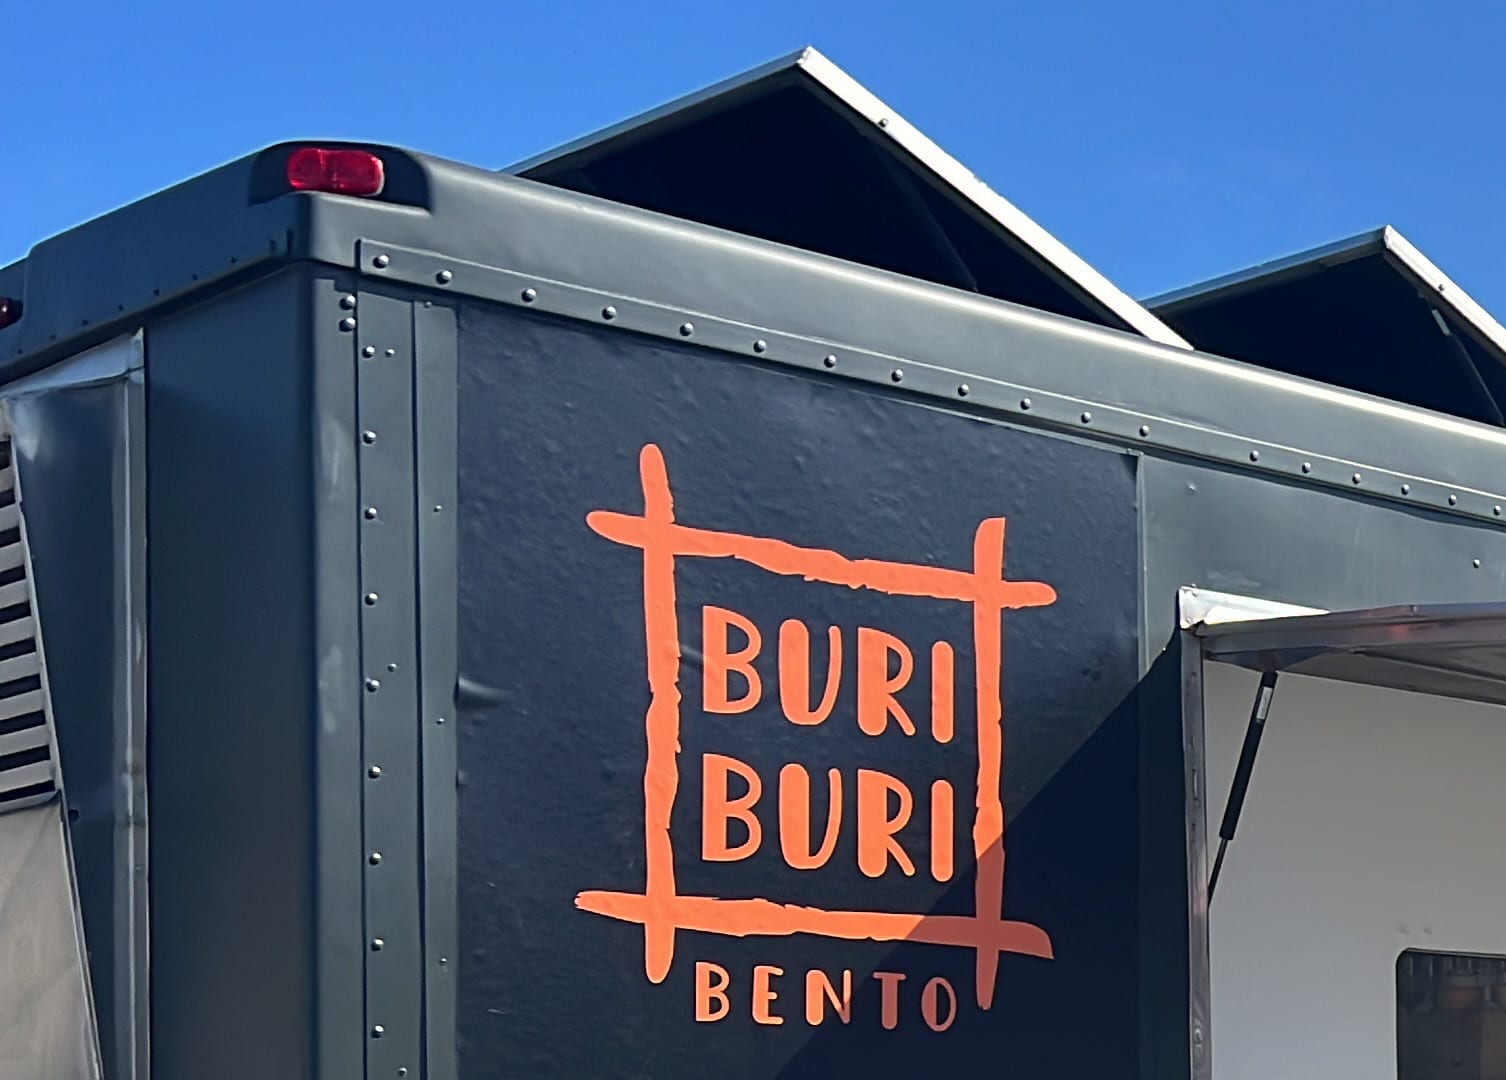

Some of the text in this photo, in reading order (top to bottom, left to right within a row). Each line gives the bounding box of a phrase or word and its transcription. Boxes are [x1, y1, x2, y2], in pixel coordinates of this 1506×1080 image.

[702, 606, 954, 744] BURI
[702, 753, 954, 882] BURI
[695, 961, 957, 1032] BENTO
